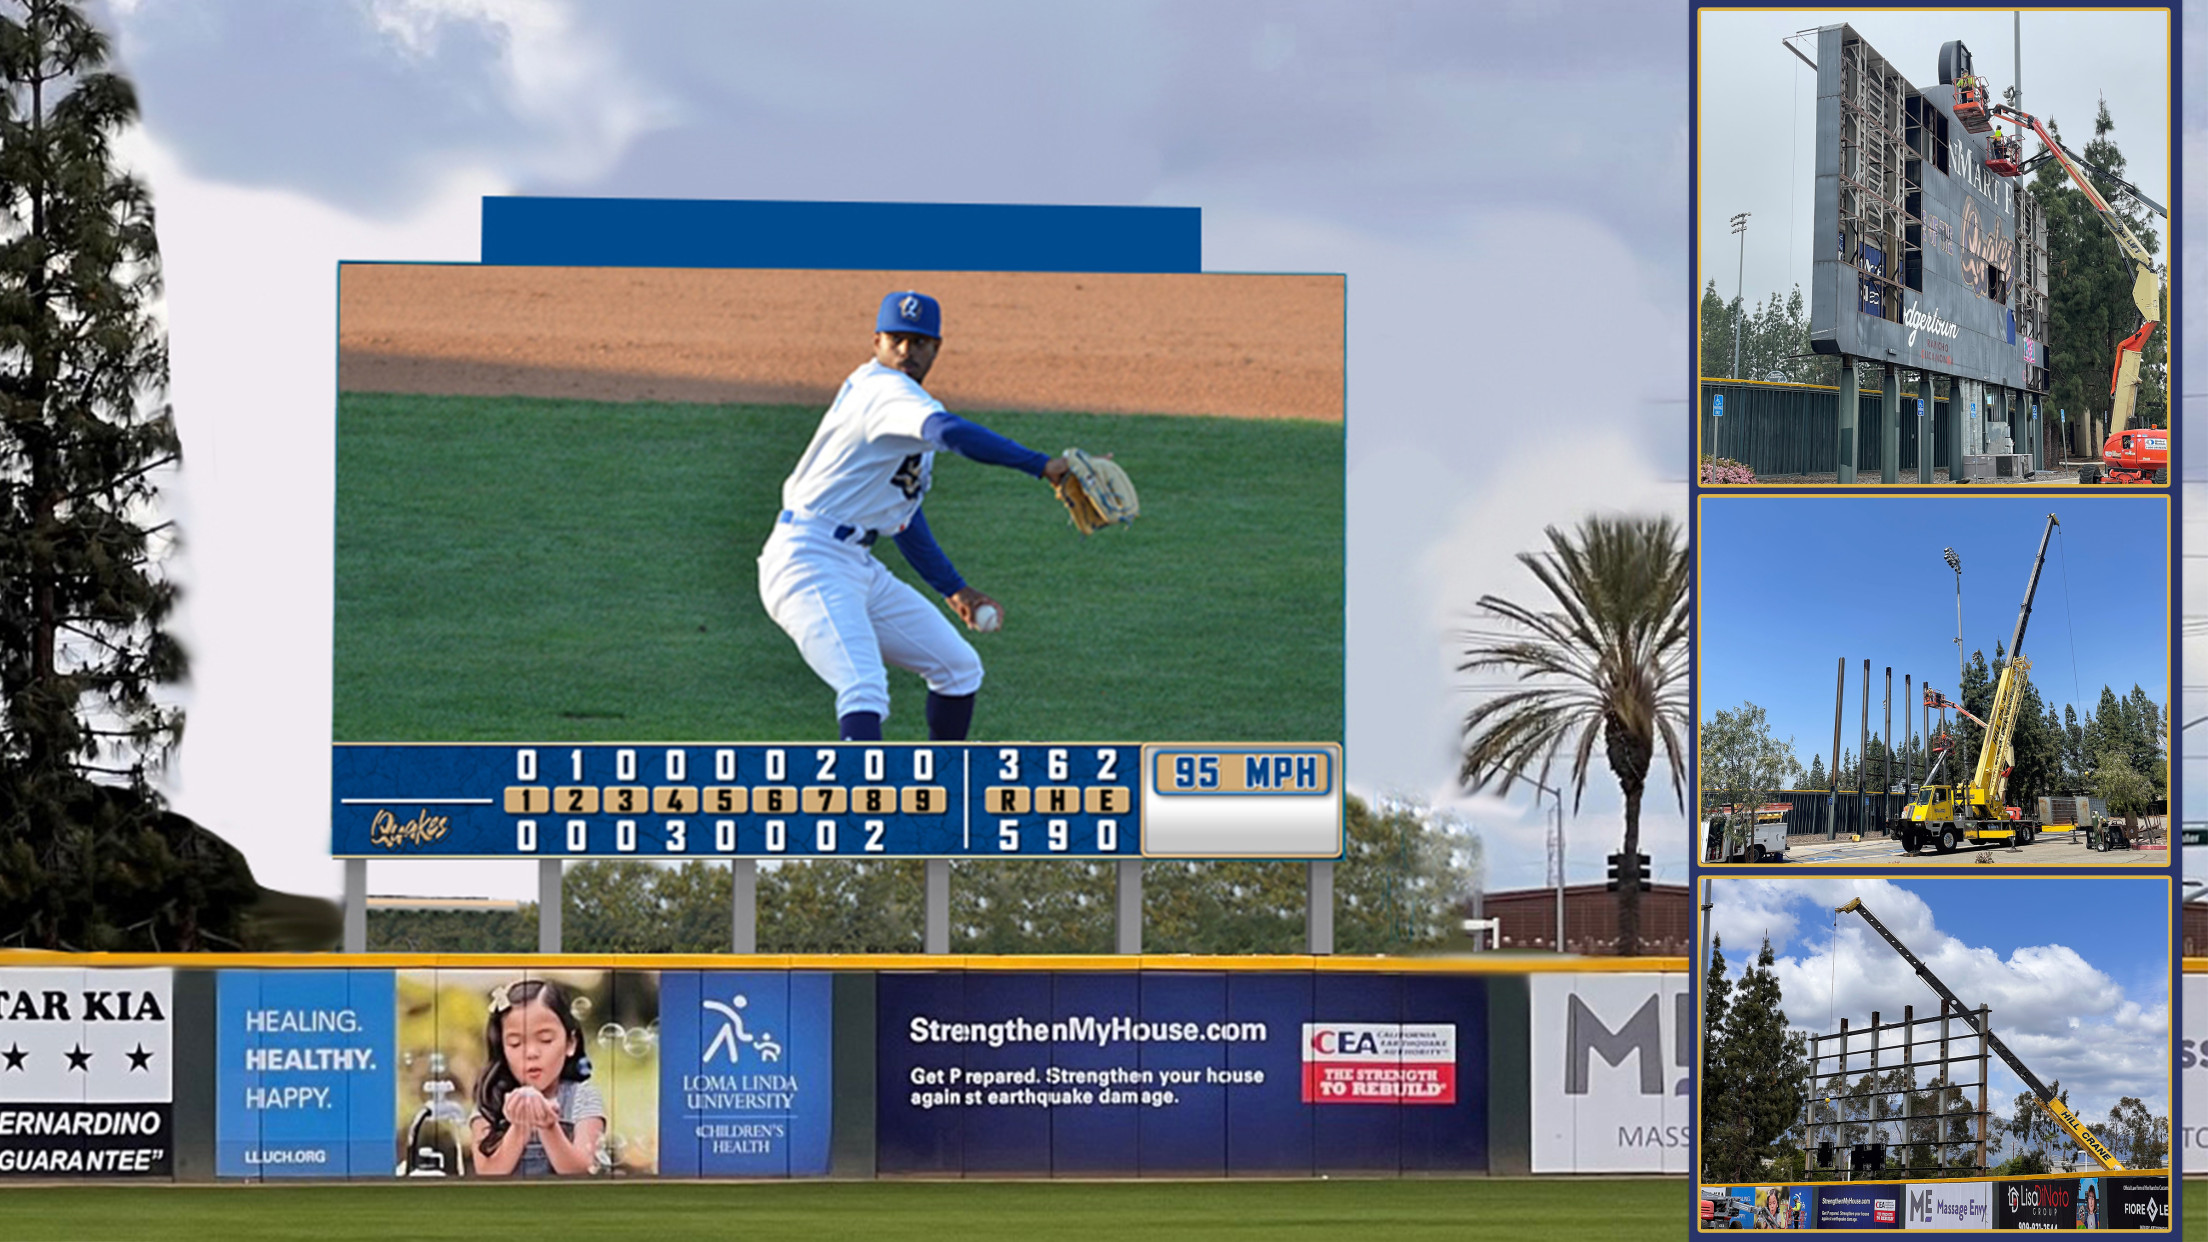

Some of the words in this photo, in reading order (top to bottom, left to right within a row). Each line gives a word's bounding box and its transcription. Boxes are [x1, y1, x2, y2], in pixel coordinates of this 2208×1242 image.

[517, 749, 537, 781] 0
[570, 749, 582, 781] 1
[616, 749, 636, 781] 0
[666, 749, 685, 781] 0
[716, 749, 735, 781] 0
[766, 749, 785, 781] 0
[816, 749, 836, 781] 2
[865, 749, 884, 781] 0
[914, 749, 933, 781] 0
[999, 749, 1018, 781] 3
[1048, 749, 1067, 781] 6
[1097, 749, 1117, 781] 2
[1175, 757, 1219, 788] 95
[1245, 757, 1317, 788] MPH
[522, 789, 531, 812] 1
[569, 789, 583, 812] 2
[618, 789, 633, 812] 3
[667, 789, 683, 812] 4
[717, 789, 732, 812] 5
[768, 789, 782, 812] 6
[818, 789, 833, 812] 7
[866, 789, 881, 812] 8
[916, 789, 930, 812] 9
[1001, 789, 1015, 812] R
[1050, 789, 1065, 812] H
[1100, 789, 1113, 812] E
[371, 808, 449, 848] Quakes
[517, 820, 537, 851] 0
[567, 820, 586, 851] 0
[616, 820, 636, 851] 0
[666, 820, 685, 851] 3
[716, 820, 735, 851] 0
[766, 820, 785, 851] 0
[816, 820, 836, 851] 0
[864, 820, 884, 851] 2
[999, 820, 1018, 851] 5
[1048, 820, 1067, 851] 9
[1097, 820, 1117, 851] 0
[82, 991, 164, 1020] KIA
[246, 1010, 362, 1032] HEALING.
[910, 1017, 1267, 1047] StrengthenMyHouse.com
[1311, 1030, 1379, 1055] CEA
[246, 1049, 376, 1071] HEALTHY.
[683, 1075, 738, 1091] LOMA
[742, 1075, 798, 1092] LINDA
[911, 1067, 944, 1085] Get
[1046, 1067, 1153, 1087] Strengthen
[1159, 1071, 1201, 1086] your
[1206, 1068, 1265, 1085] house
[1324, 1068, 1353, 1081] THE
[1356, 1070, 1438, 1082] STRENGTH
[246, 1088, 331, 1109] HAPPY.
[987, 1089, 1093, 1107] earthquake
[1320, 1082, 1347, 1096] TO
[687, 1093, 794, 1109] UNIVERSITY
[0, 1111, 161, 1136] ERNARDINO
[696, 1124, 784, 1138] CHILDREN'S
[713, 1140, 770, 1154] HEALTH
[1619, 1126, 1689, 1148] MASS
[2061, 1111, 2080, 1131] HILL
[2082, 1132, 2112, 1161] CRANE
[245, 1150, 326, 1164] LLUCH.ORG
[1910, 1189, 1933, 1222] ME
[1937, 1199, 1968, 1221] Massage
[1969, 1199, 1987, 1222] Envy
[2033, 1207, 2058, 1216] GROUP
[2124, 1203, 2146, 1215] FIORE
